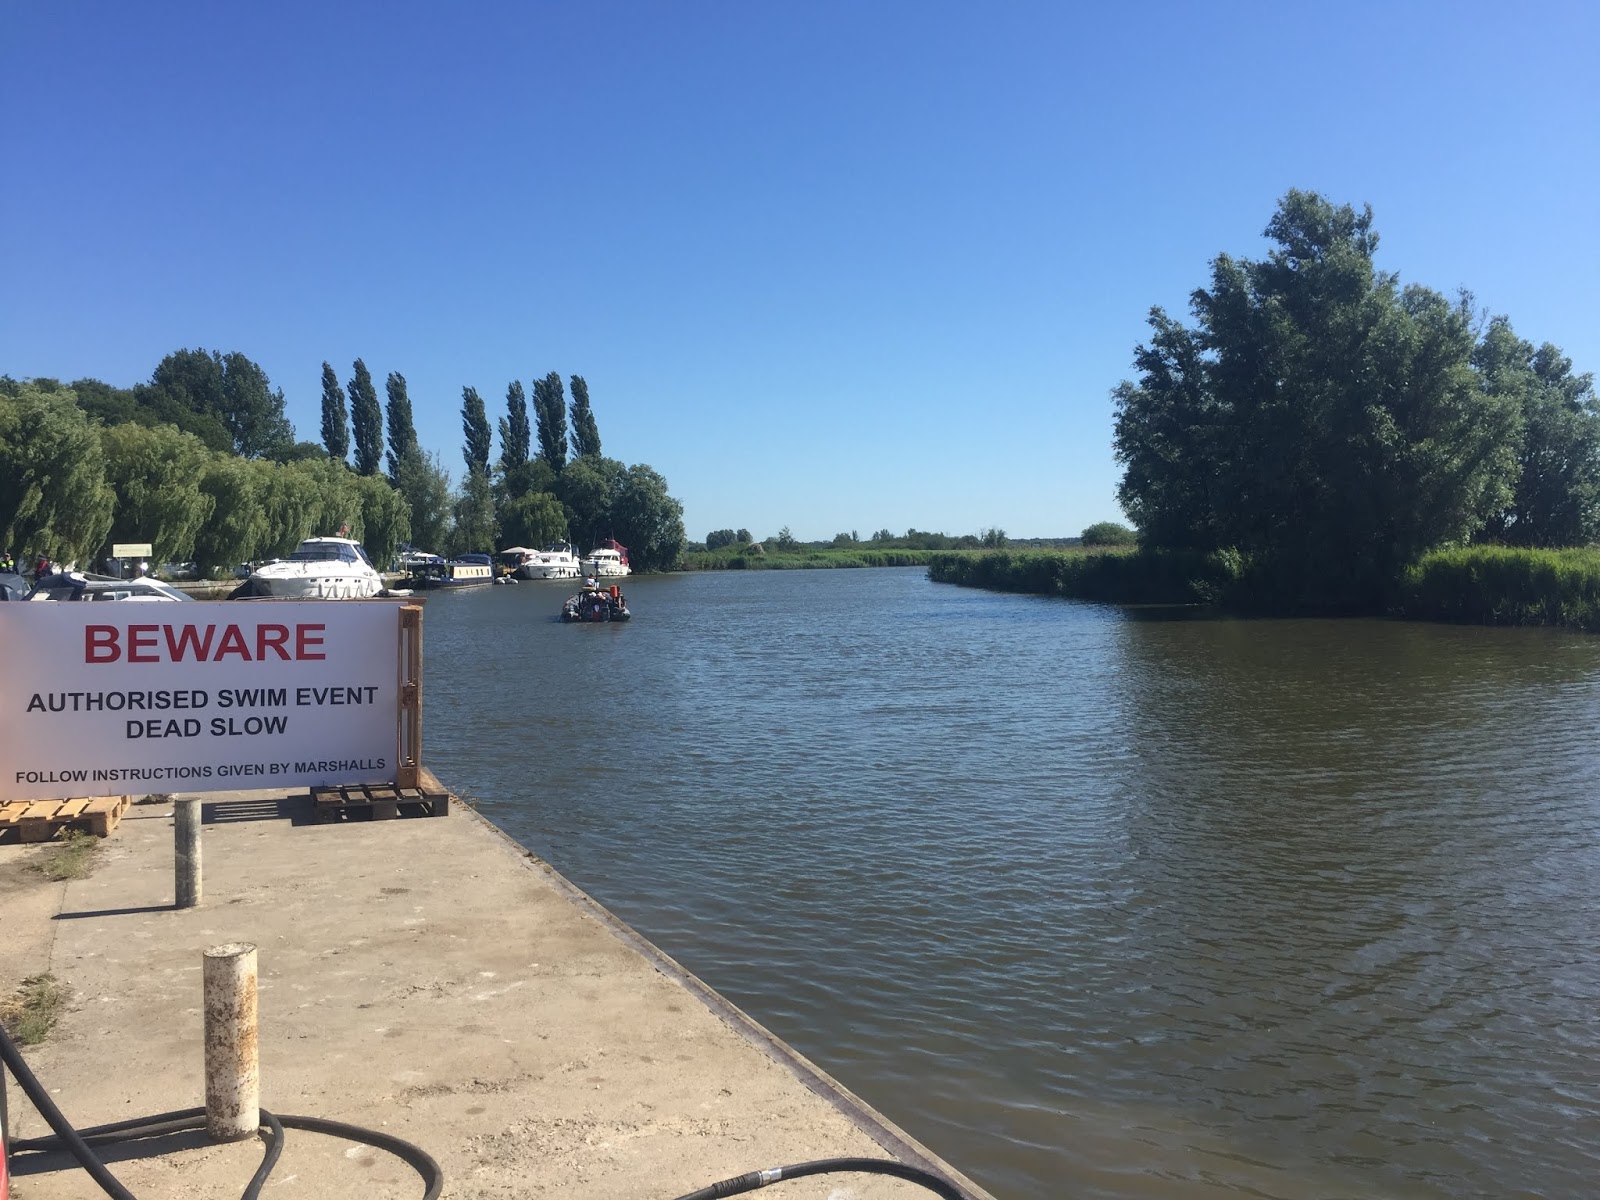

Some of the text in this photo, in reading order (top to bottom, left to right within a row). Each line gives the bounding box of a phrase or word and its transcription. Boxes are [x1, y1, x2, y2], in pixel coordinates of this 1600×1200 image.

[85, 624, 326, 663] BEWARE
[27, 687, 379, 712] AUTHORISED SWIM EVENT
[126, 716, 288, 738] DEAD SLOW
[16, 758, 386, 784] FOLLOW INSTRUCTIONS GIVEN BY MARSHALLS
